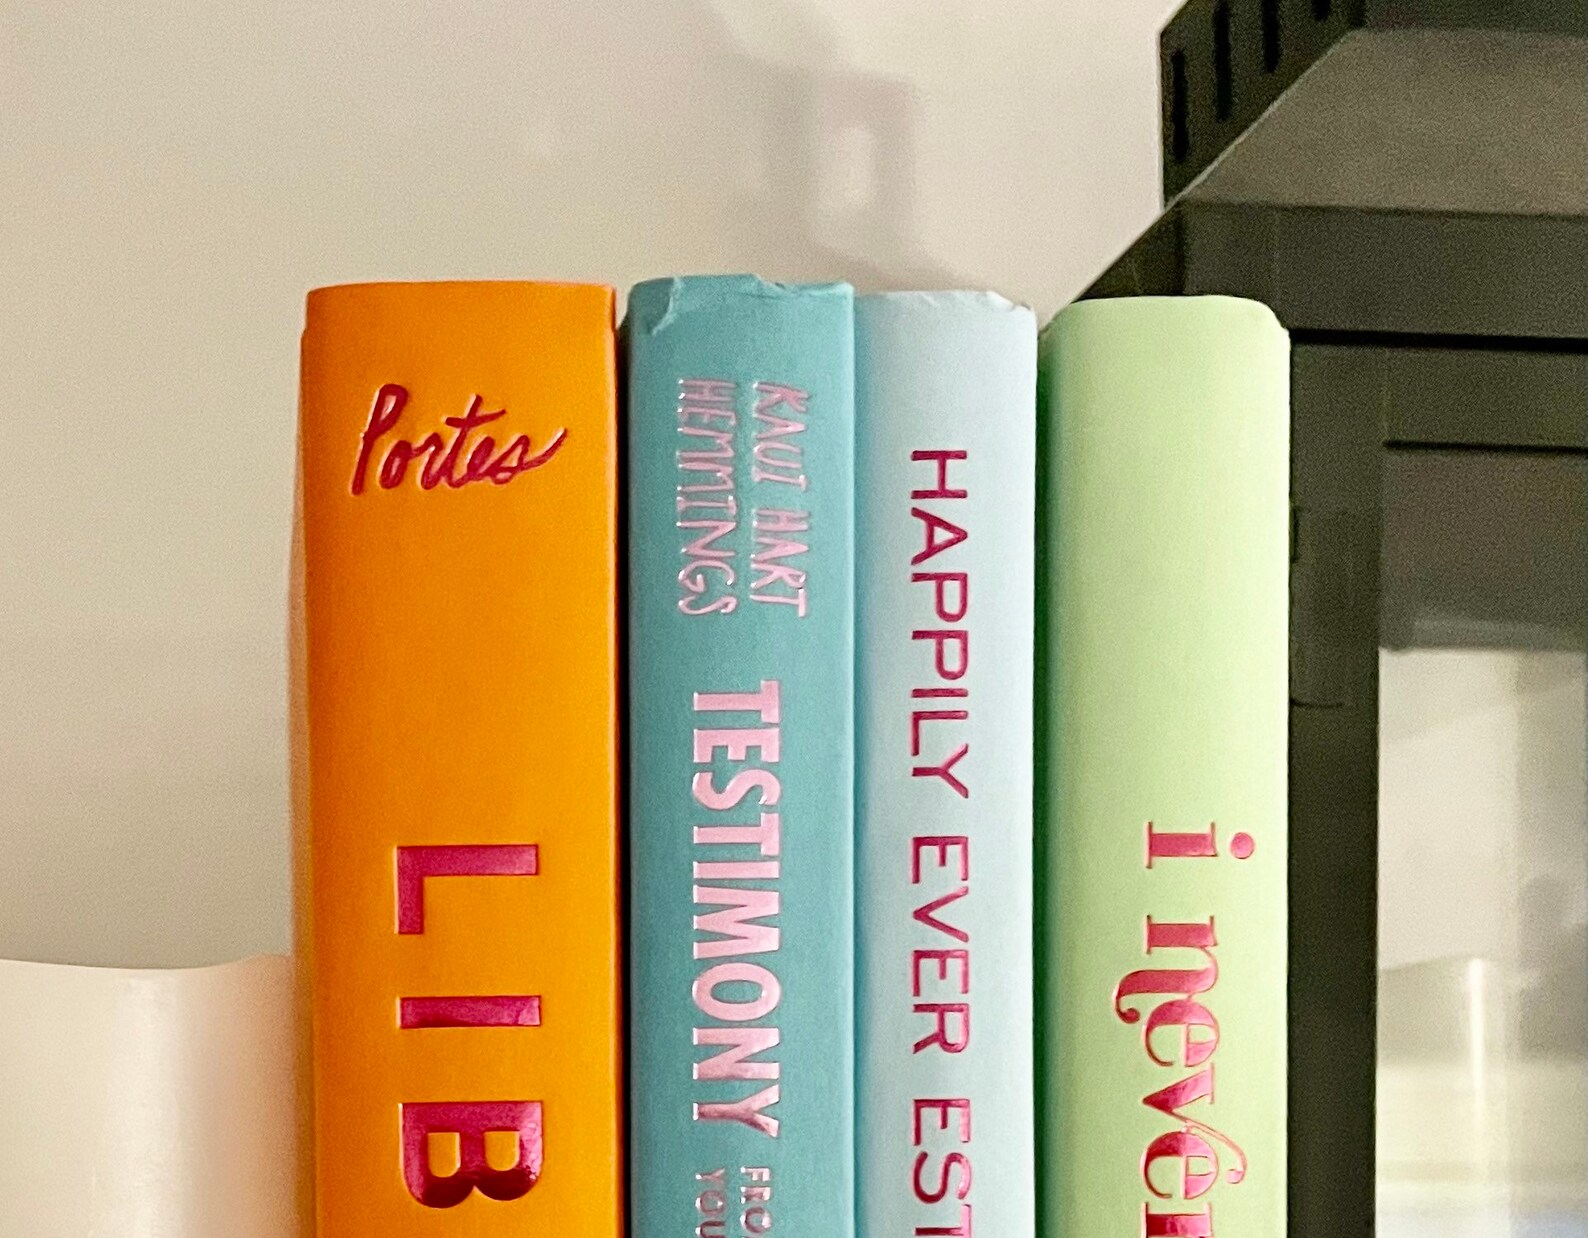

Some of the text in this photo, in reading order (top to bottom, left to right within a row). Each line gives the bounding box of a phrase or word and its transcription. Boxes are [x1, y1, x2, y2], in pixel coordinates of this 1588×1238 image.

[349, 383, 567, 496] Portes
[677, 378, 738, 617] HEMMINGS
[749, 381, 812, 618] KAUI HART
[910, 450, 969, 799] HAPPILY
[692, 679, 782, 1138] TESTIMONY
[911, 836, 970, 1055] EVER
[1146, 821, 1256, 869] i
